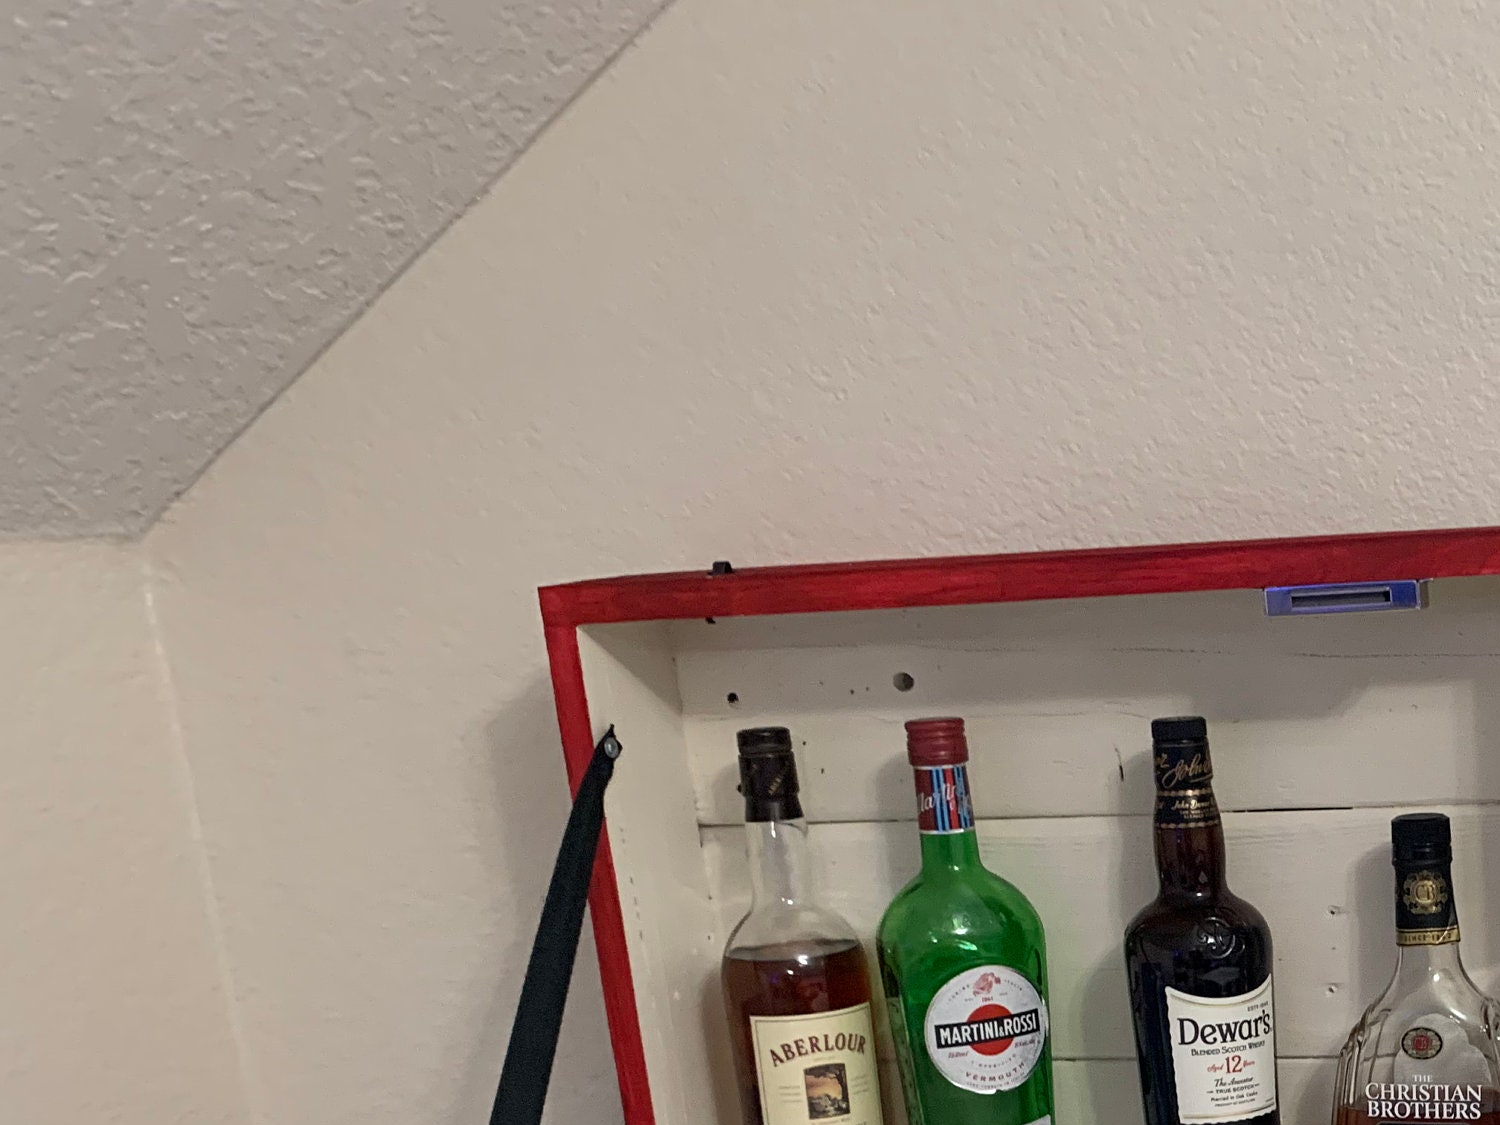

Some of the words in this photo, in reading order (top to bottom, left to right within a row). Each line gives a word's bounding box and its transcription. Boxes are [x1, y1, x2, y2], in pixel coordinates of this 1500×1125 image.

[1177, 1009, 1271, 1045] Dewar's
[769, 1032, 867, 1068] ABERLOUR
[1222, 1044, 1247, 1055] SCOTCH
[965, 1062, 1025, 1082] VERMOUTH
[1225, 1054, 1242, 1074] 12
[1214, 1077, 1227, 1087] The
[1412, 1075, 1433, 1083] THE
[1365, 1083, 1482, 1102] CHRISTIAN
[1367, 1101, 1482, 1120] BROTHERS
